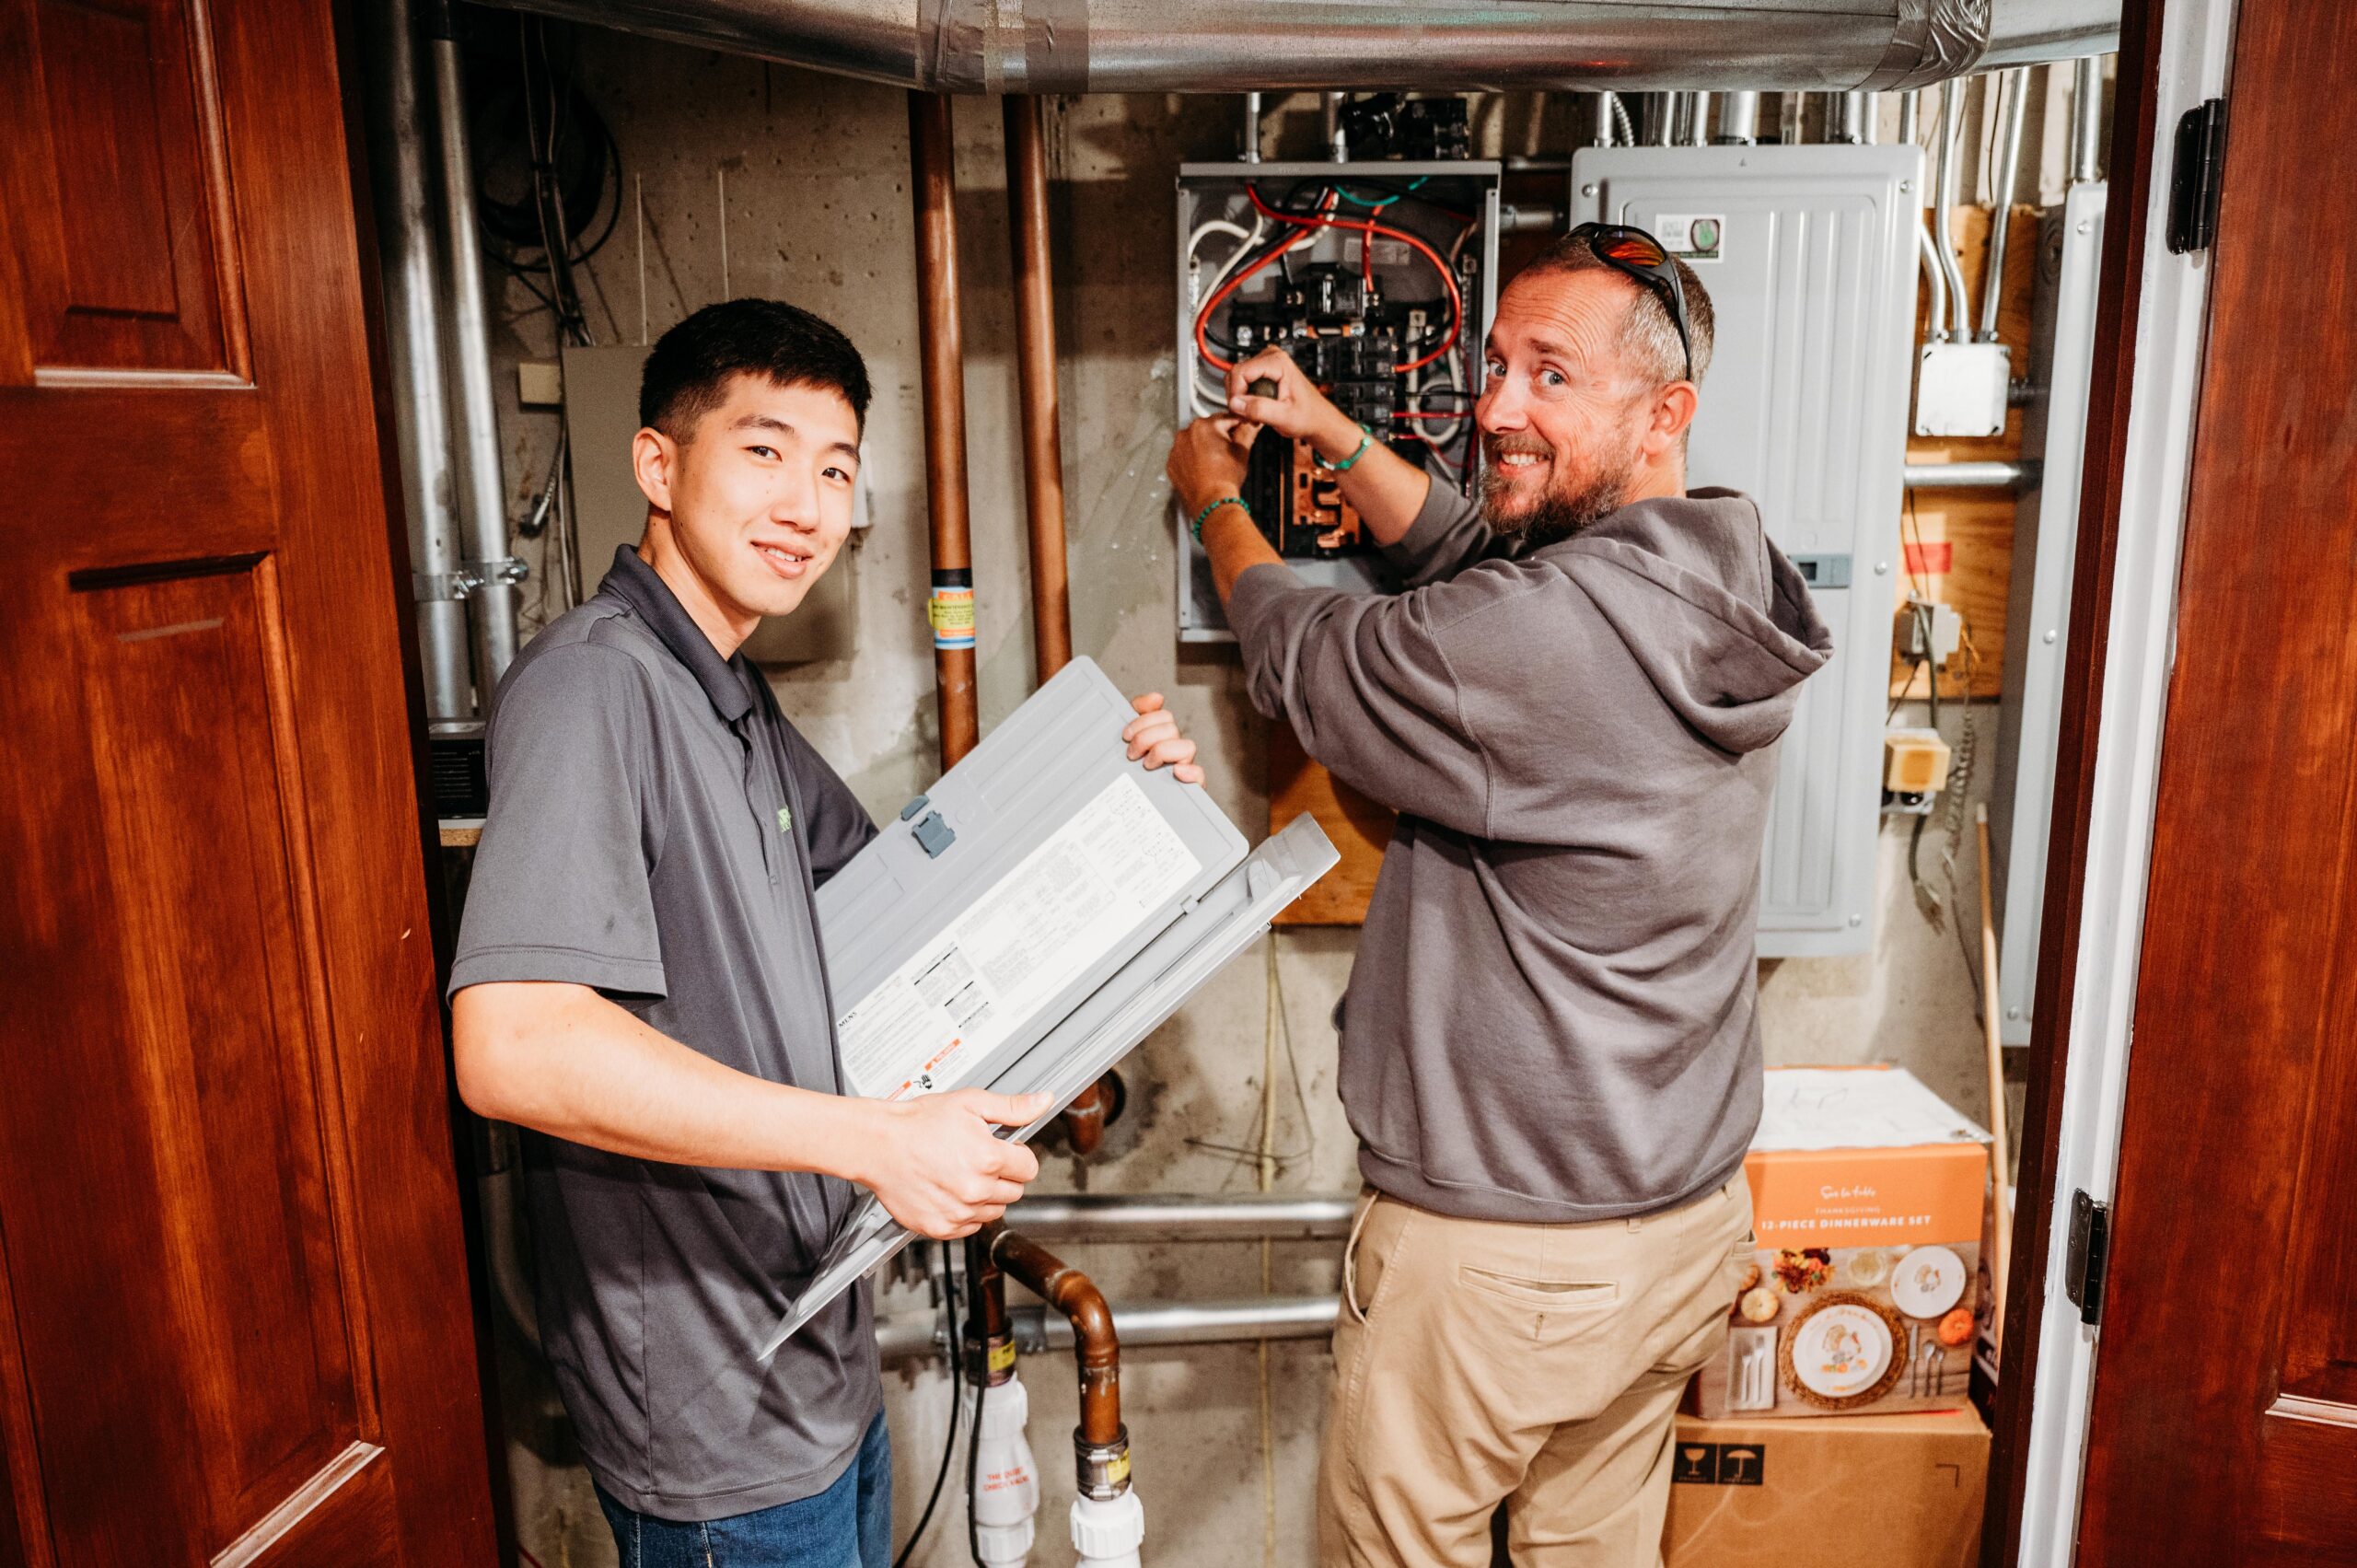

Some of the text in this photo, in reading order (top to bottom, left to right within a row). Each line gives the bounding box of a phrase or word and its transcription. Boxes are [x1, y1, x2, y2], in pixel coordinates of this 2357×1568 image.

[839, 1011, 857, 1028] MENS
[1761, 1214, 1932, 1231] 12-PIECE DINNERWARE SET
